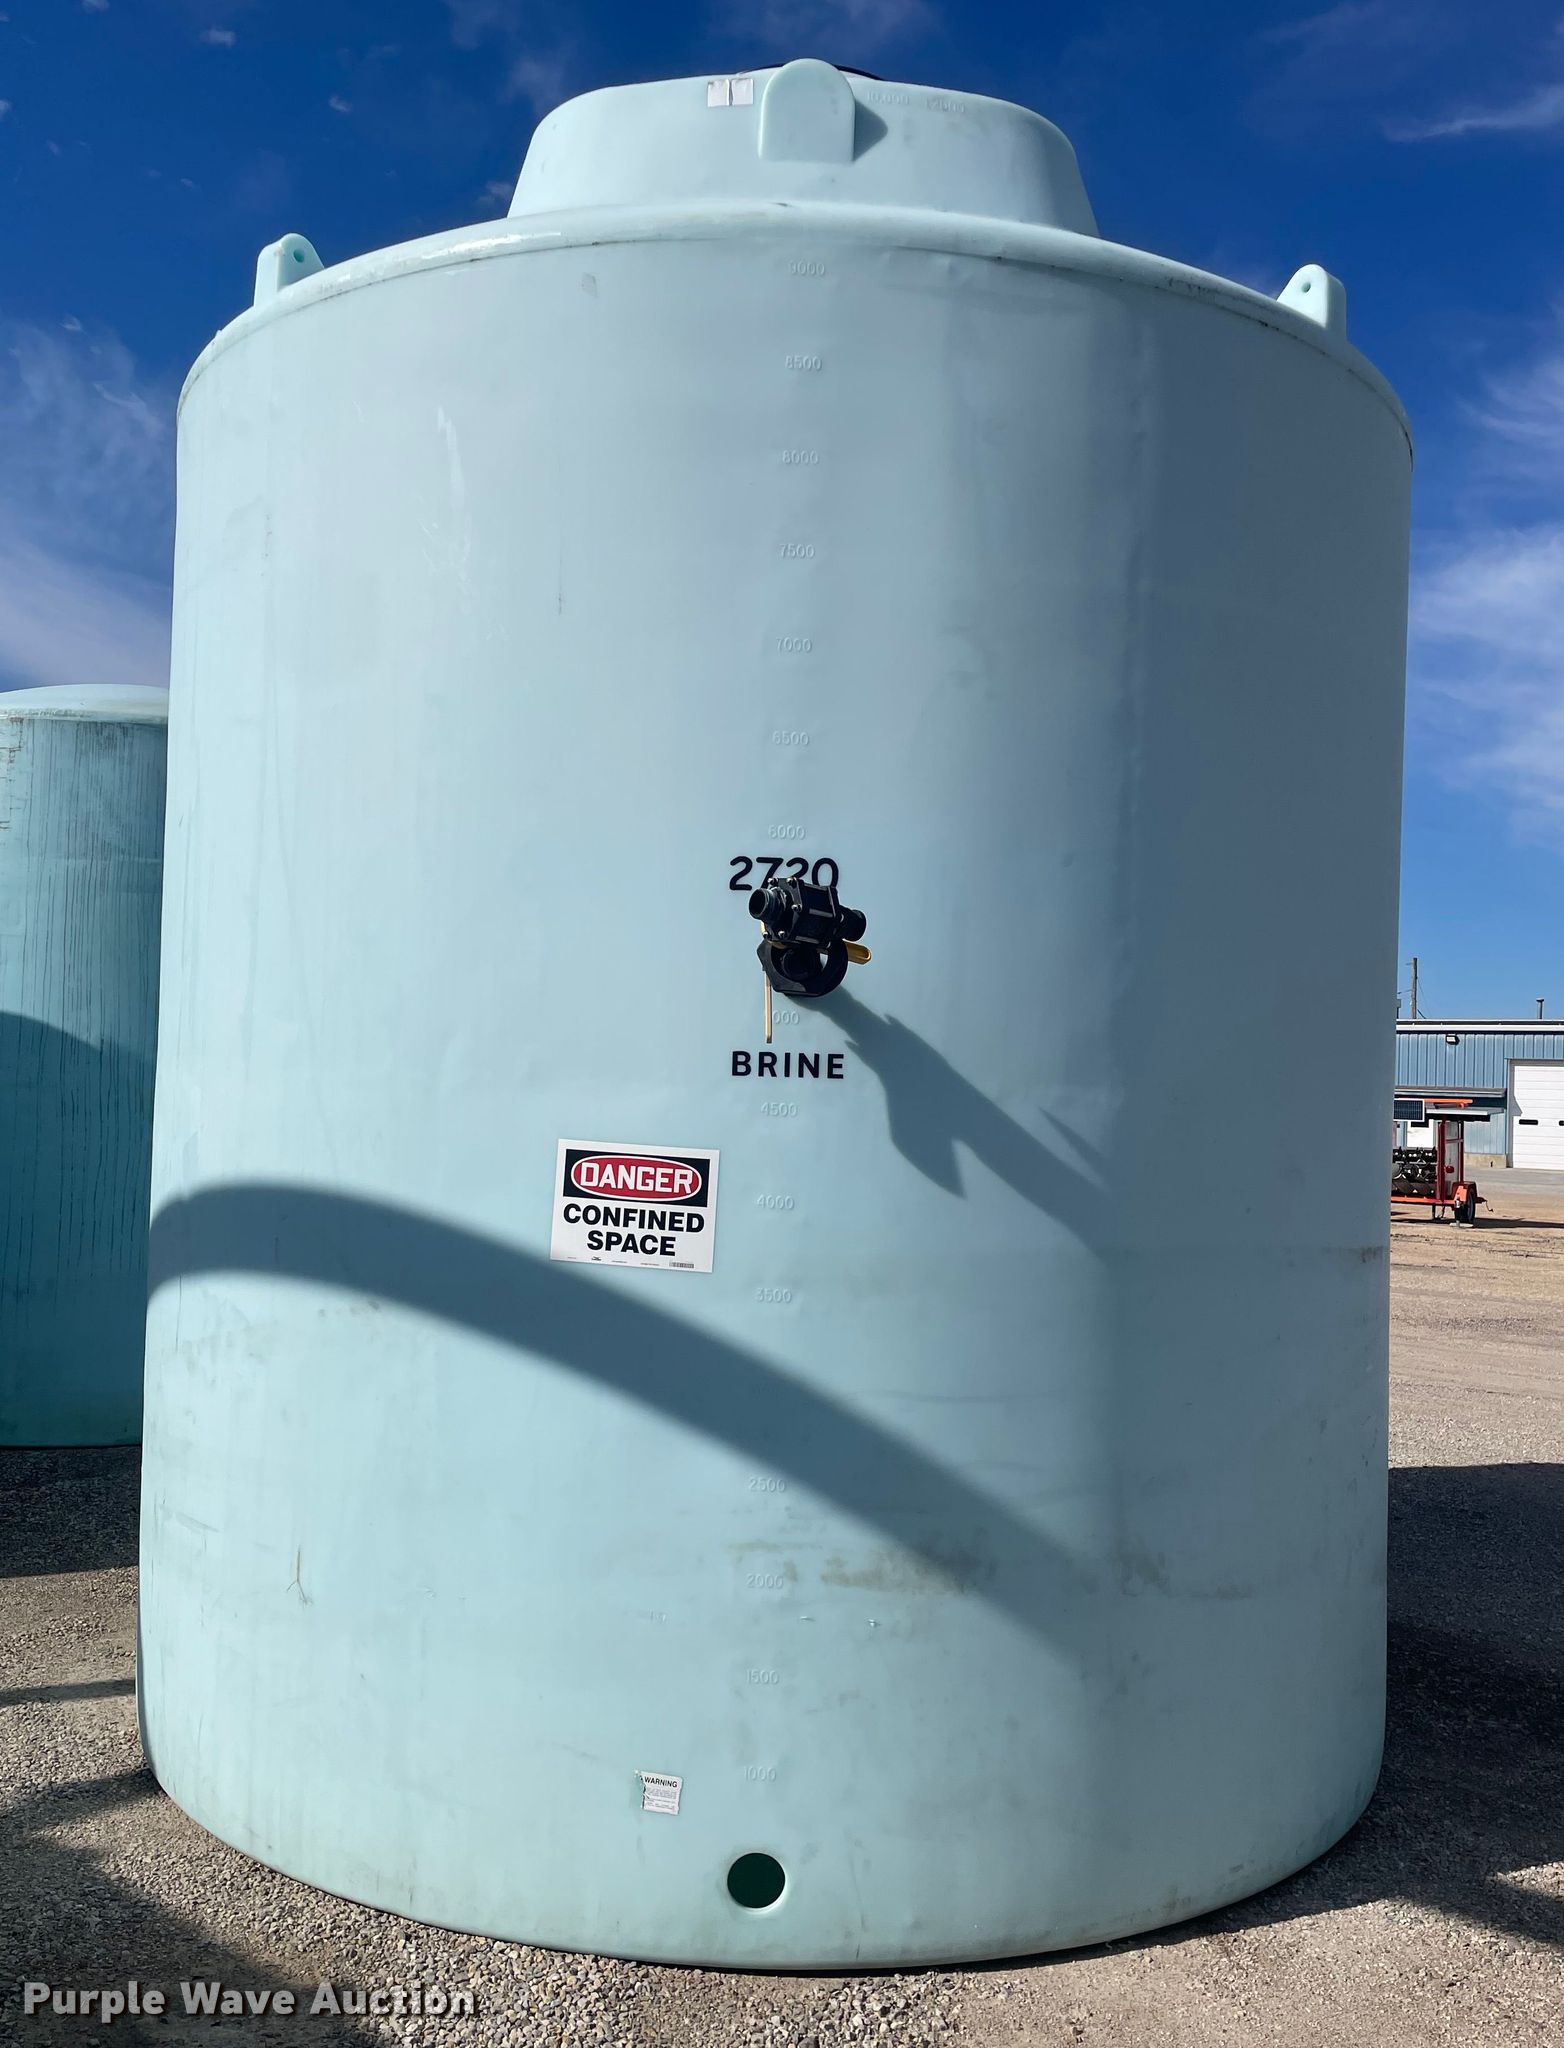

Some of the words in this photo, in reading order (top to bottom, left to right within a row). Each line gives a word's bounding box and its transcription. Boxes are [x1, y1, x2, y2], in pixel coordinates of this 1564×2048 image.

[789, 260, 825, 276] 9000
[782, 450, 819, 465] 8000
[779, 544, 816, 559] 7500
[776, 637, 813, 653] 7000
[772, 731, 810, 746] 6500
[768, 824, 806, 840] 6000
[772, 1010, 800, 1025] 000
[731, 1051, 845, 1079] BRINE
[760, 1102, 798, 1117] 4500
[580, 1162, 694, 1194] DANGER
[757, 1194, 795, 1210] 4000
[563, 1203, 705, 1233] CONFINED
[587, 1230, 676, 1256] SPACE
[756, 1287, 793, 1303] 3500
[749, 1476, 786, 1492] 2500
[747, 1573, 784, 1589] 2000
[746, 1669, 780, 1685] 1500
[644, 1776, 678, 1788] WARNING
[744, 1766, 777, 1783] 1000
